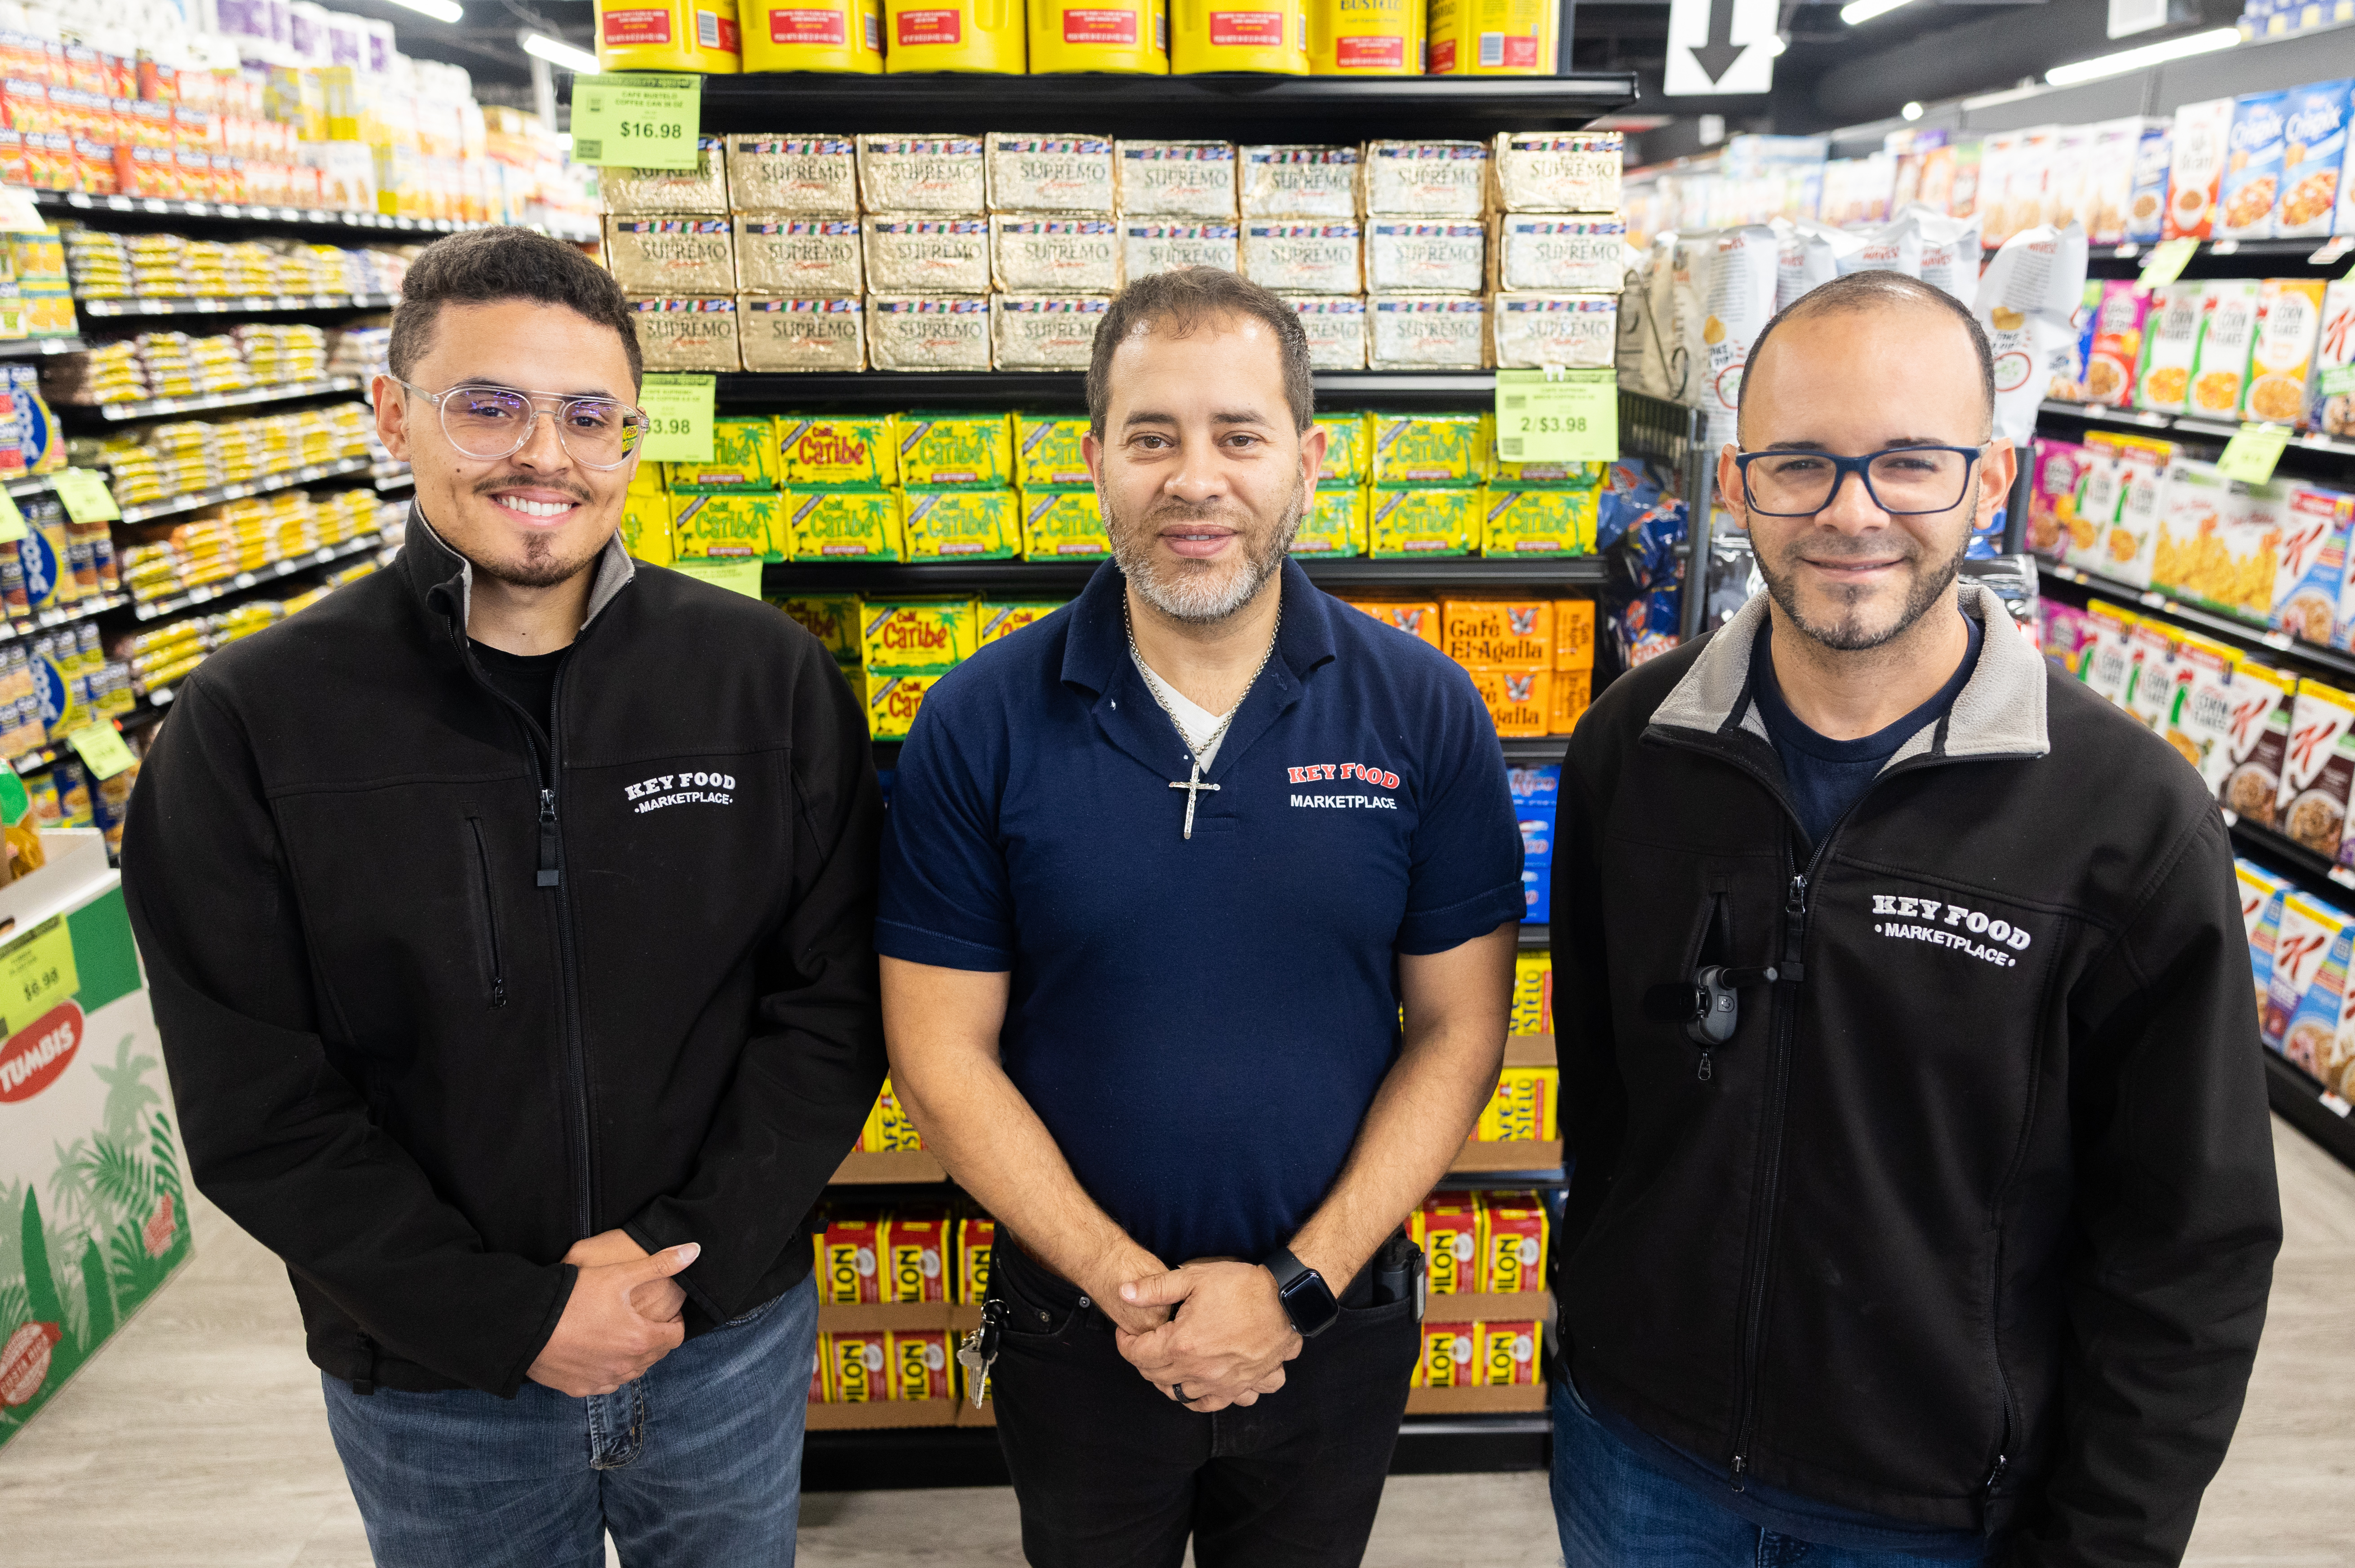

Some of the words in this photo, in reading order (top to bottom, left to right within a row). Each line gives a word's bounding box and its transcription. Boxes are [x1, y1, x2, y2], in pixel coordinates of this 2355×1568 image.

[621, 121, 682, 139] $16.98
[761, 164, 847, 180] SUPREMO
[1020, 164, 1105, 180] SUPREMO
[1145, 170, 1228, 187] SUPREMO
[1398, 168, 1479, 184] SUPREMO
[1531, 161, 1615, 177] SUPREMO
[642, 243, 727, 261] SUPREMO
[769, 244, 853, 261] SUPREMO
[898, 243, 983, 260] SUPREMO
[1025, 244, 1109, 260] SUPREMO
[1149, 247, 1232, 263] SUPREMO
[1271, 247, 1352, 263] SUPREMO
[1396, 245, 1477, 261] SUPREMO
[1535, 244, 1619, 261] SUPREMO
[647, 320, 731, 338] SUPREMO
[772, 320, 856, 338] SUPREMO
[899, 322, 983, 338] SUPREMO
[1024, 322, 1095, 338] SUPREM
[1397, 322, 1478, 337] SUPREMO
[1528, 321, 1610, 337] SUPREMO
[645, 419, 689, 434] 3.98
[799, 436, 864, 465] Caribe
[919, 436, 984, 465] Caribe
[1397, 434, 1460, 462] Caribe
[696, 511, 759, 539] Caribe
[811, 510, 874, 537] Caribe
[927, 508, 990, 536] Caribe
[1393, 506, 1456, 534] Caribe
[1506, 506, 1567, 534] Caribe
[2283, 522, 2324, 577] K
[883, 622, 947, 649] Caribe
[1450, 613, 1500, 638] Café
[2230, 698, 2267, 747] K
[2291, 721, 2336, 773] K
[625, 775, 674, 801] KEY
[679, 772, 736, 790] FOOD
[1287, 764, 1336, 784] KEY
[1340, 762, 1400, 789] FOOD
[639, 792, 730, 813] MARKETPLACE
[1291, 794, 1397, 809] MARKETPLACE
[1872, 895, 1942, 920] KEY
[1944, 904, 2031, 950] FOOD
[1885, 922, 2009, 966] MARKETPLACE
[2279, 935, 2325, 981] K
[0, 1020, 75, 1094] TUMBIS
[834, 1249, 856, 1302] ILON
[899, 1249, 920, 1302] ILON
[1434, 1235, 1453, 1294] ILON
[1497, 1238, 1518, 1289] ILON
[843, 1344, 864, 1403] ILON
[905, 1344, 925, 1401] ILON
[1432, 1337, 1451, 1387] ILON
[1492, 1336, 1512, 1385] ILON
